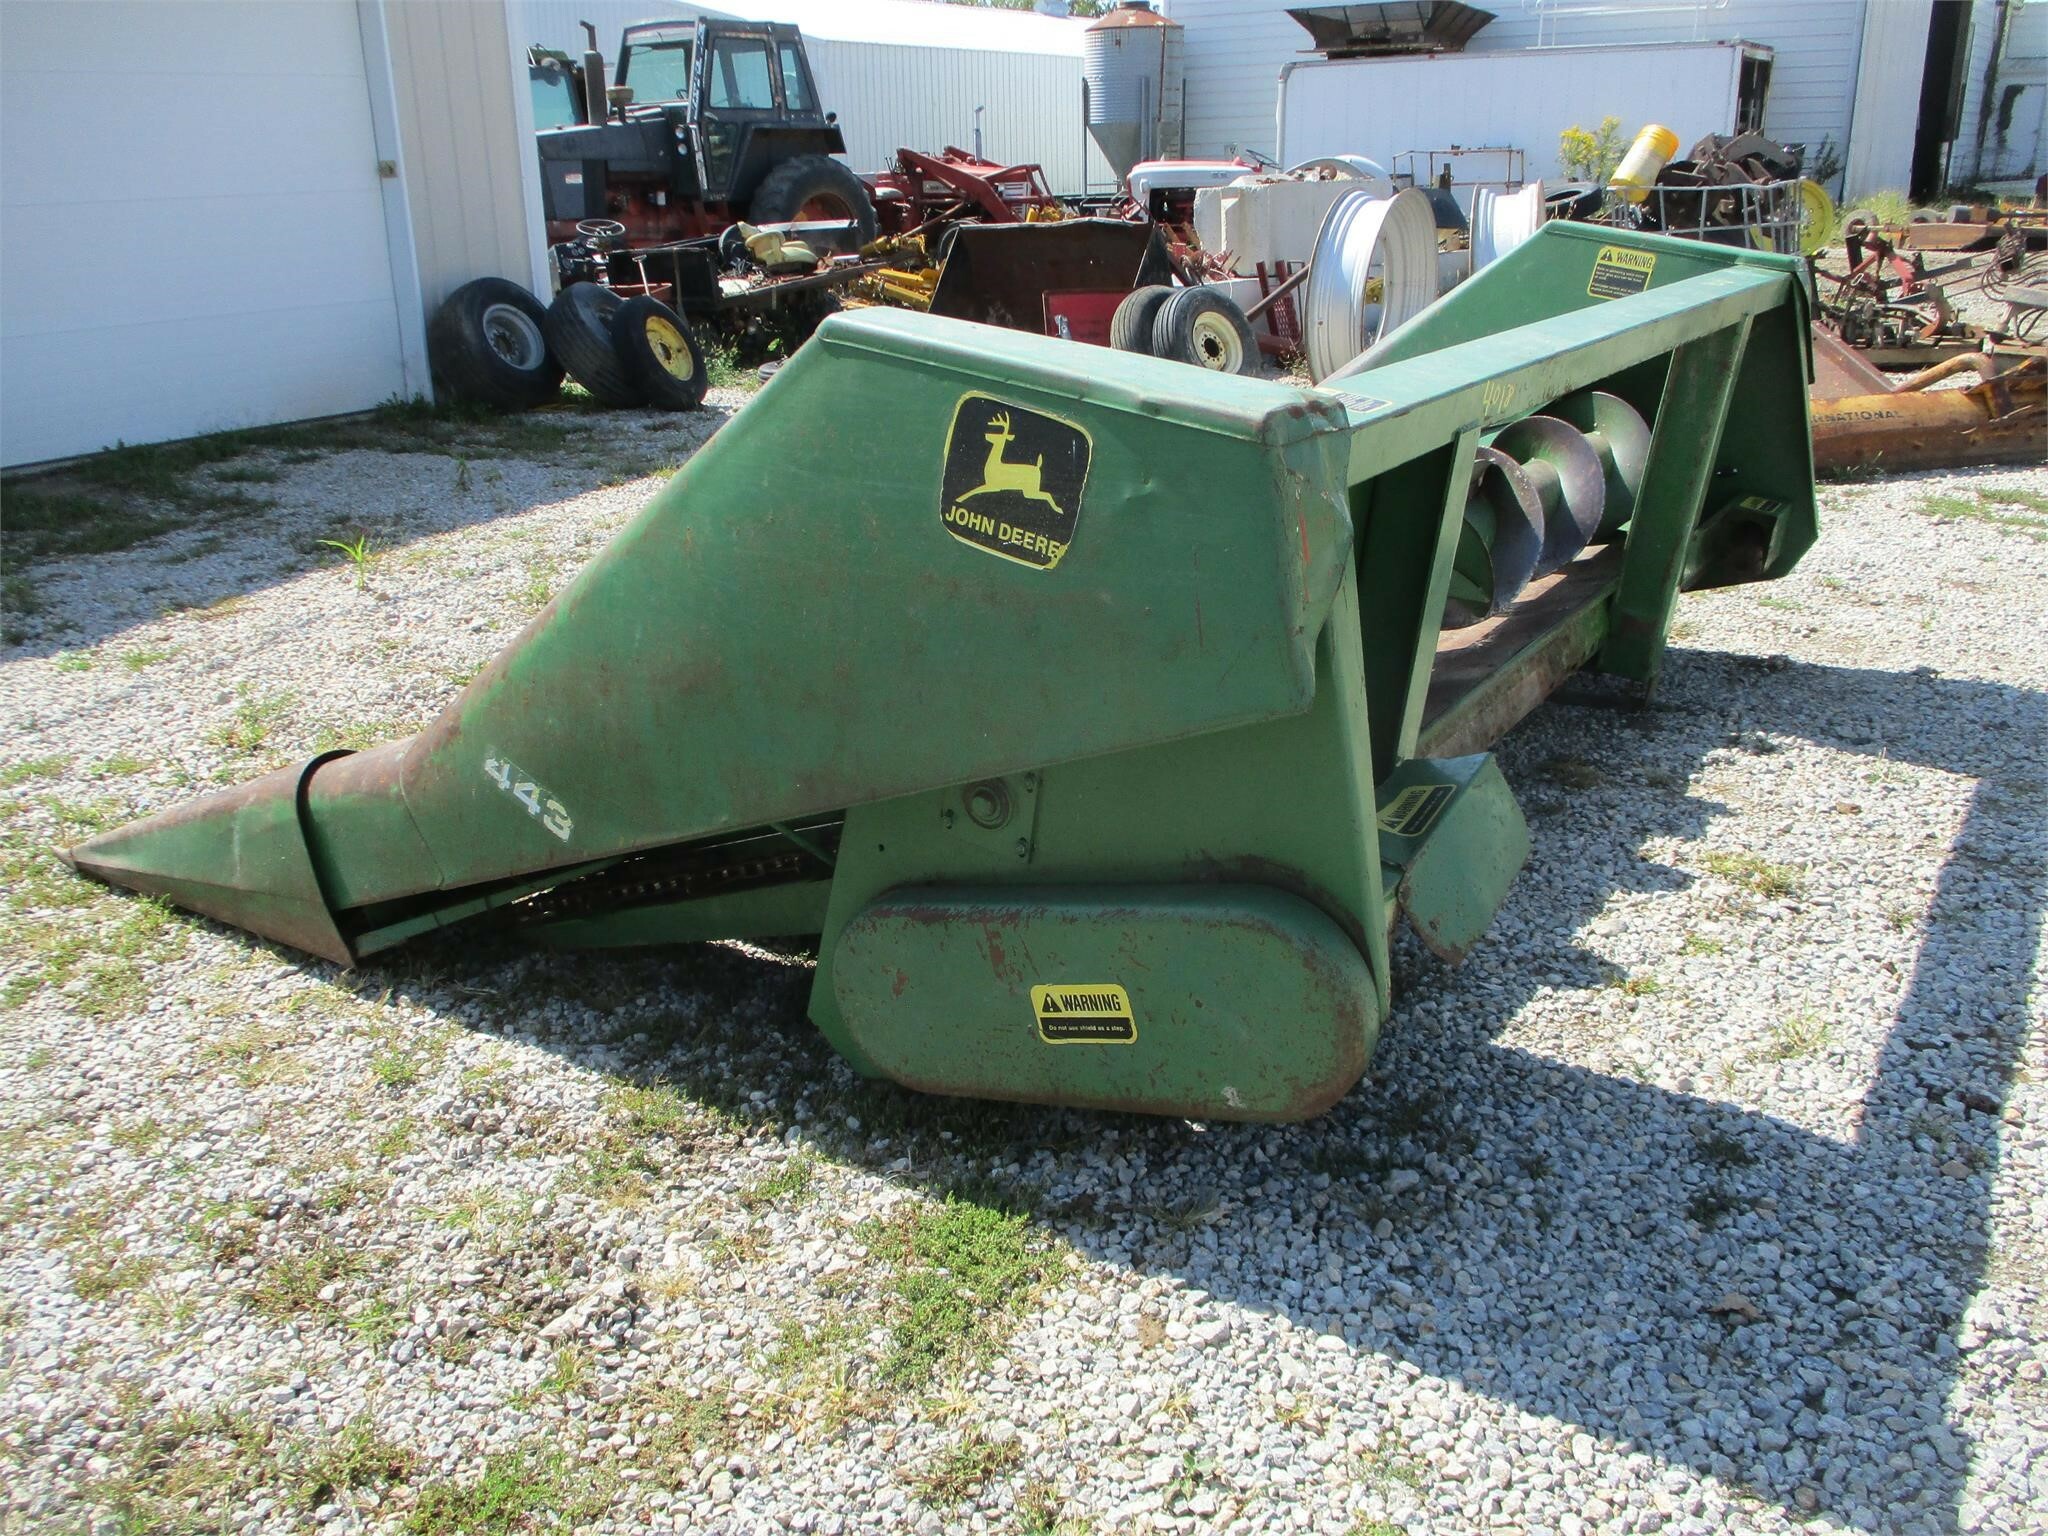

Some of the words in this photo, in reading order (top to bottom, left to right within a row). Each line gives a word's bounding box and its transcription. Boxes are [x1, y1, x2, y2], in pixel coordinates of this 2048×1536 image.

[1616, 251, 1653, 269] WARNING
[1810, 409, 1904, 424] RNATIONAL
[945, 505, 996, 536] JOHN
[998, 522, 1061, 559] DEERE
[484, 758, 574, 842] 443
[1388, 790, 1427, 820] WARNING
[1060, 994, 1122, 1012] WARNING
